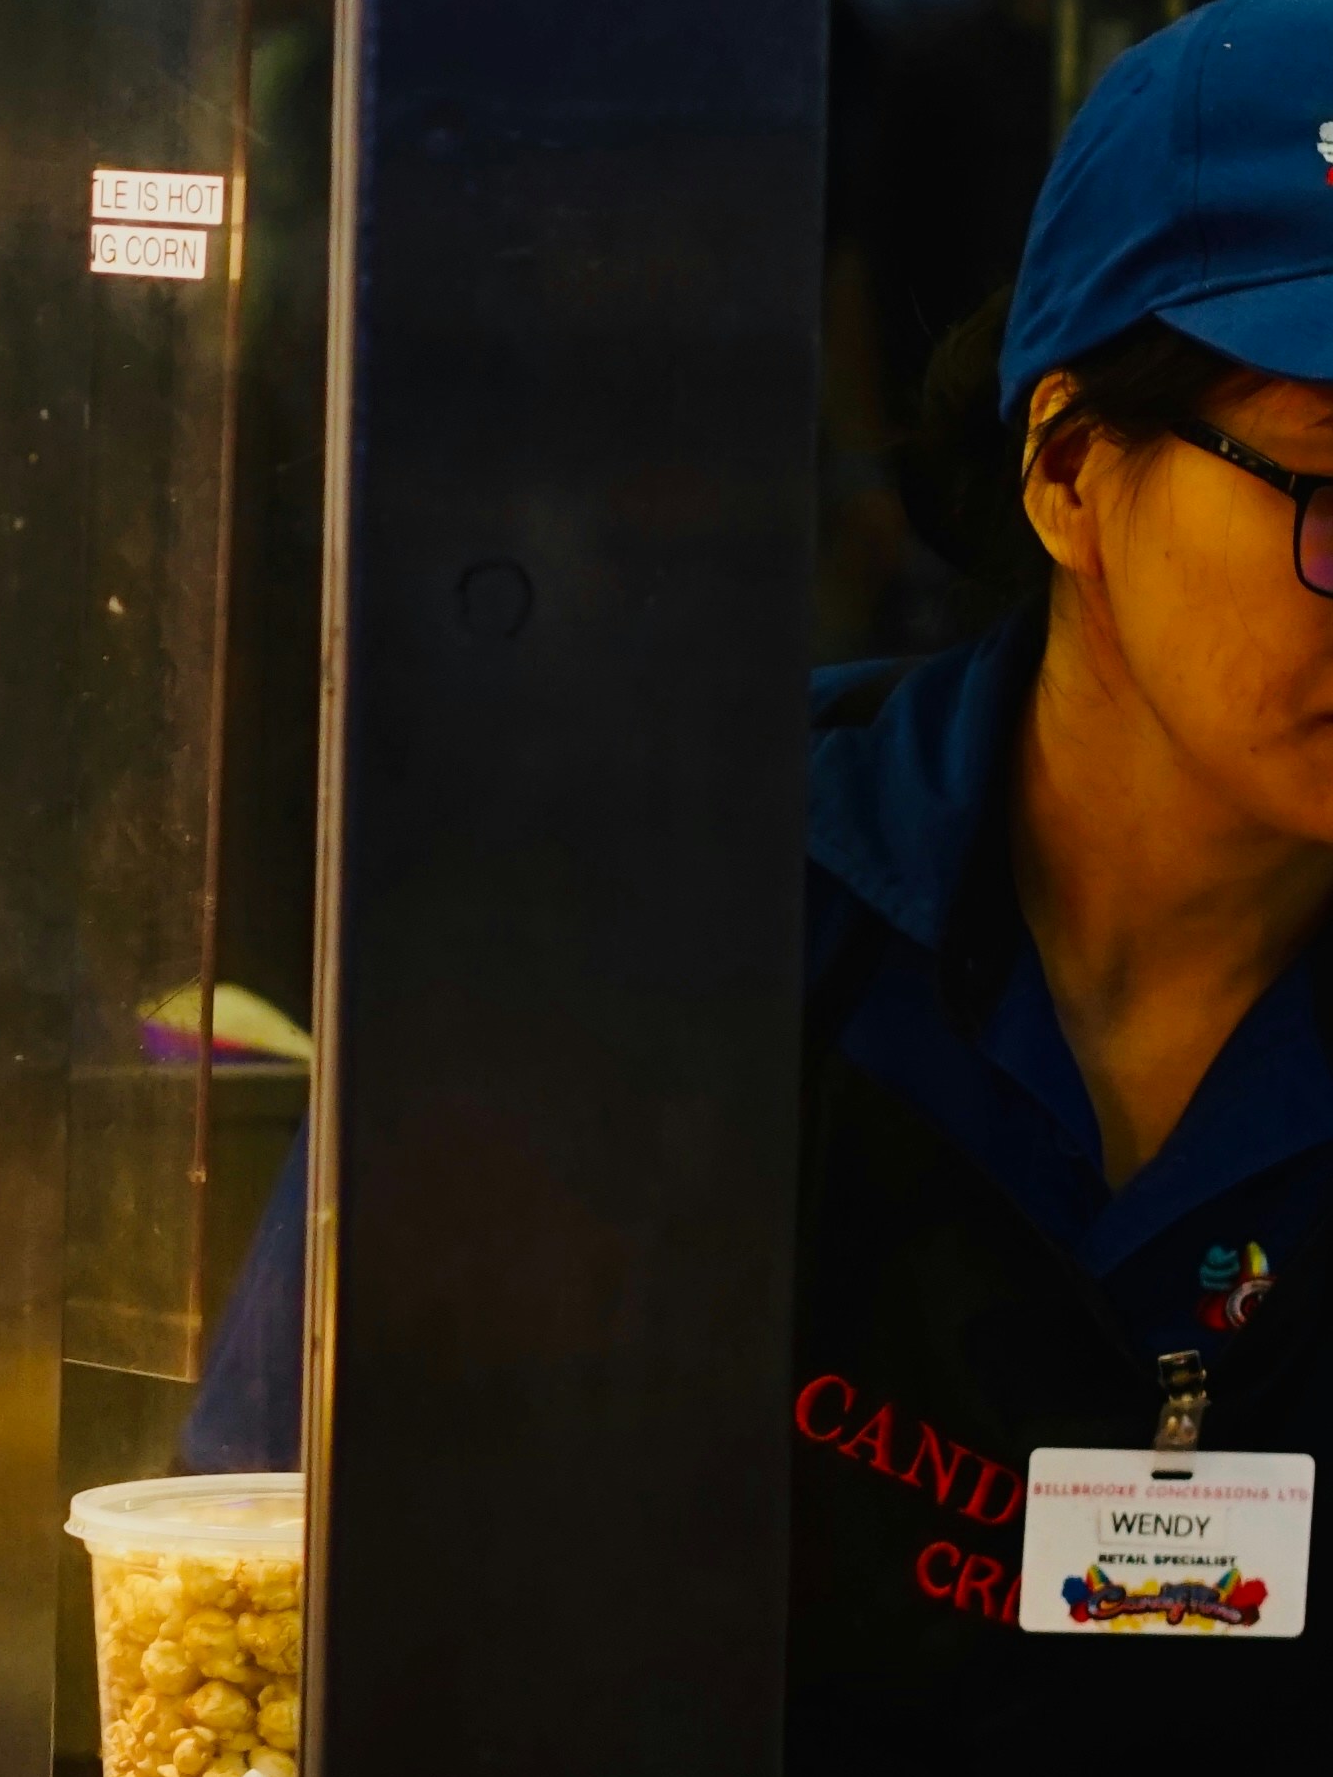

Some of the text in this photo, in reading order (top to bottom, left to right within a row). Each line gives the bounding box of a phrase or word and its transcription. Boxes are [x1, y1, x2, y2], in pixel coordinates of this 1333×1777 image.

[93, 178, 219, 215] LE IS HOT
[125, 236, 197, 269] CORN
[1145, 1485, 1271, 1501] CONCESSIONS
[1111, 1510, 1211, 1539] WENDY
[1098, 1553, 1237, 1567] RETAIL SPECIALIST
